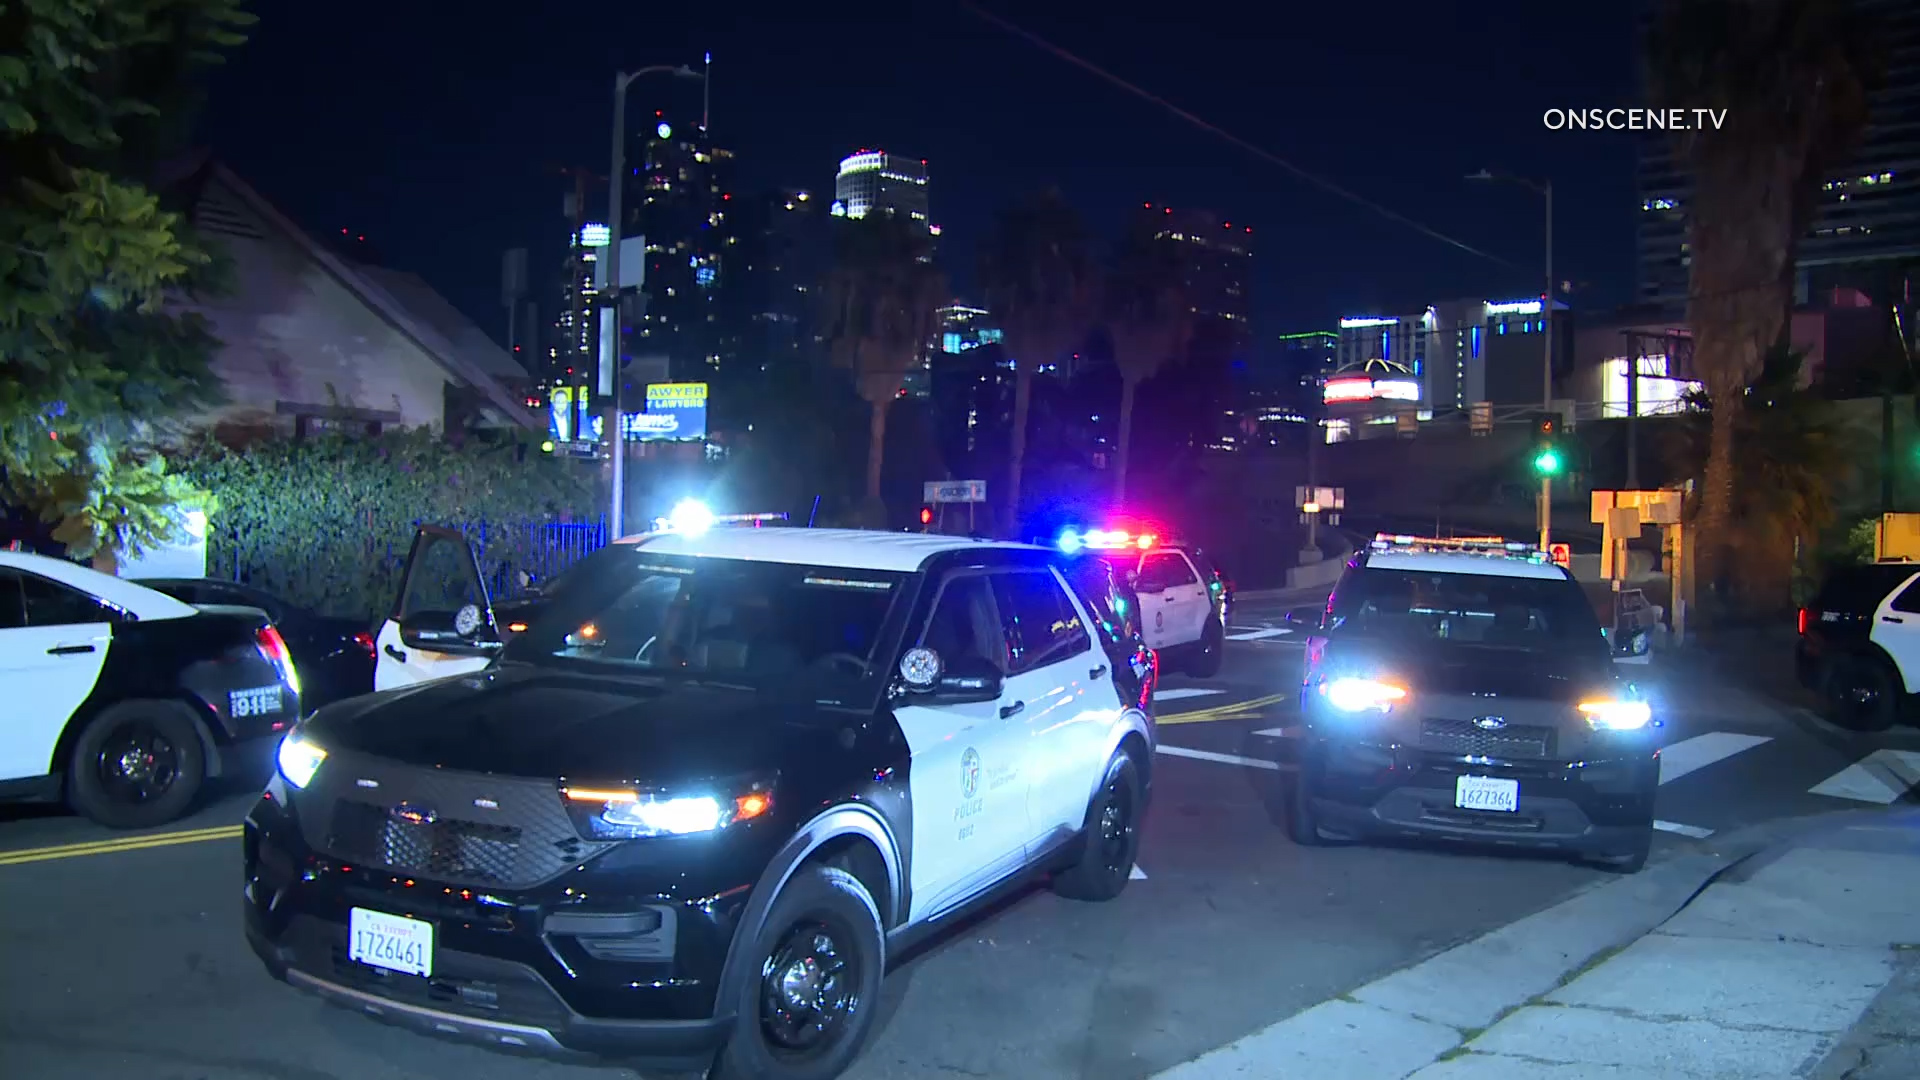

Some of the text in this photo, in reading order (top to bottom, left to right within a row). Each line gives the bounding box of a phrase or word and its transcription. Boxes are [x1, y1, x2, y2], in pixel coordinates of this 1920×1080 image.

[648, 386, 704, 397] AWYER
[1461, 789, 1512, 806] 1627364
[953, 797, 983, 822] POLICE
[356, 929, 424, 967] 1726461
